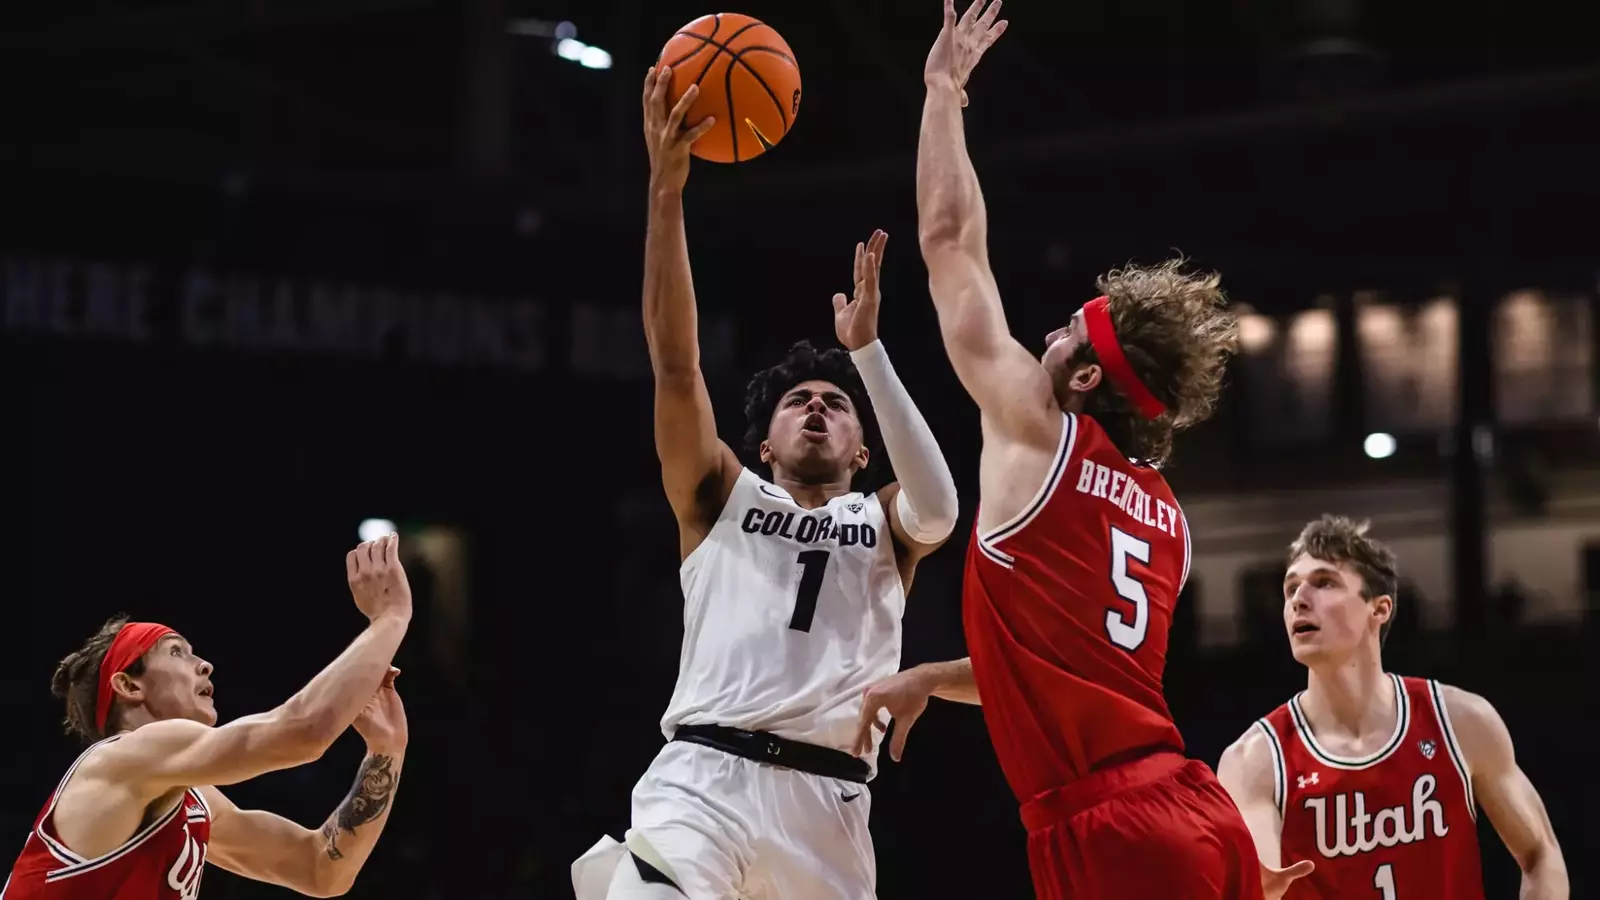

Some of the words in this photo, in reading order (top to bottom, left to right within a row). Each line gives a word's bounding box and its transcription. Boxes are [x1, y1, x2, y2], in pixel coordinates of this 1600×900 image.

[741, 507, 877, 548] COLORADO
[1076, 459, 1177, 539] BRENCHLEY
[788, 549, 830, 633] 1
[1105, 525, 1150, 652] 5
[1304, 774, 1449, 858] Utah
[1374, 863, 1397, 900] 1
